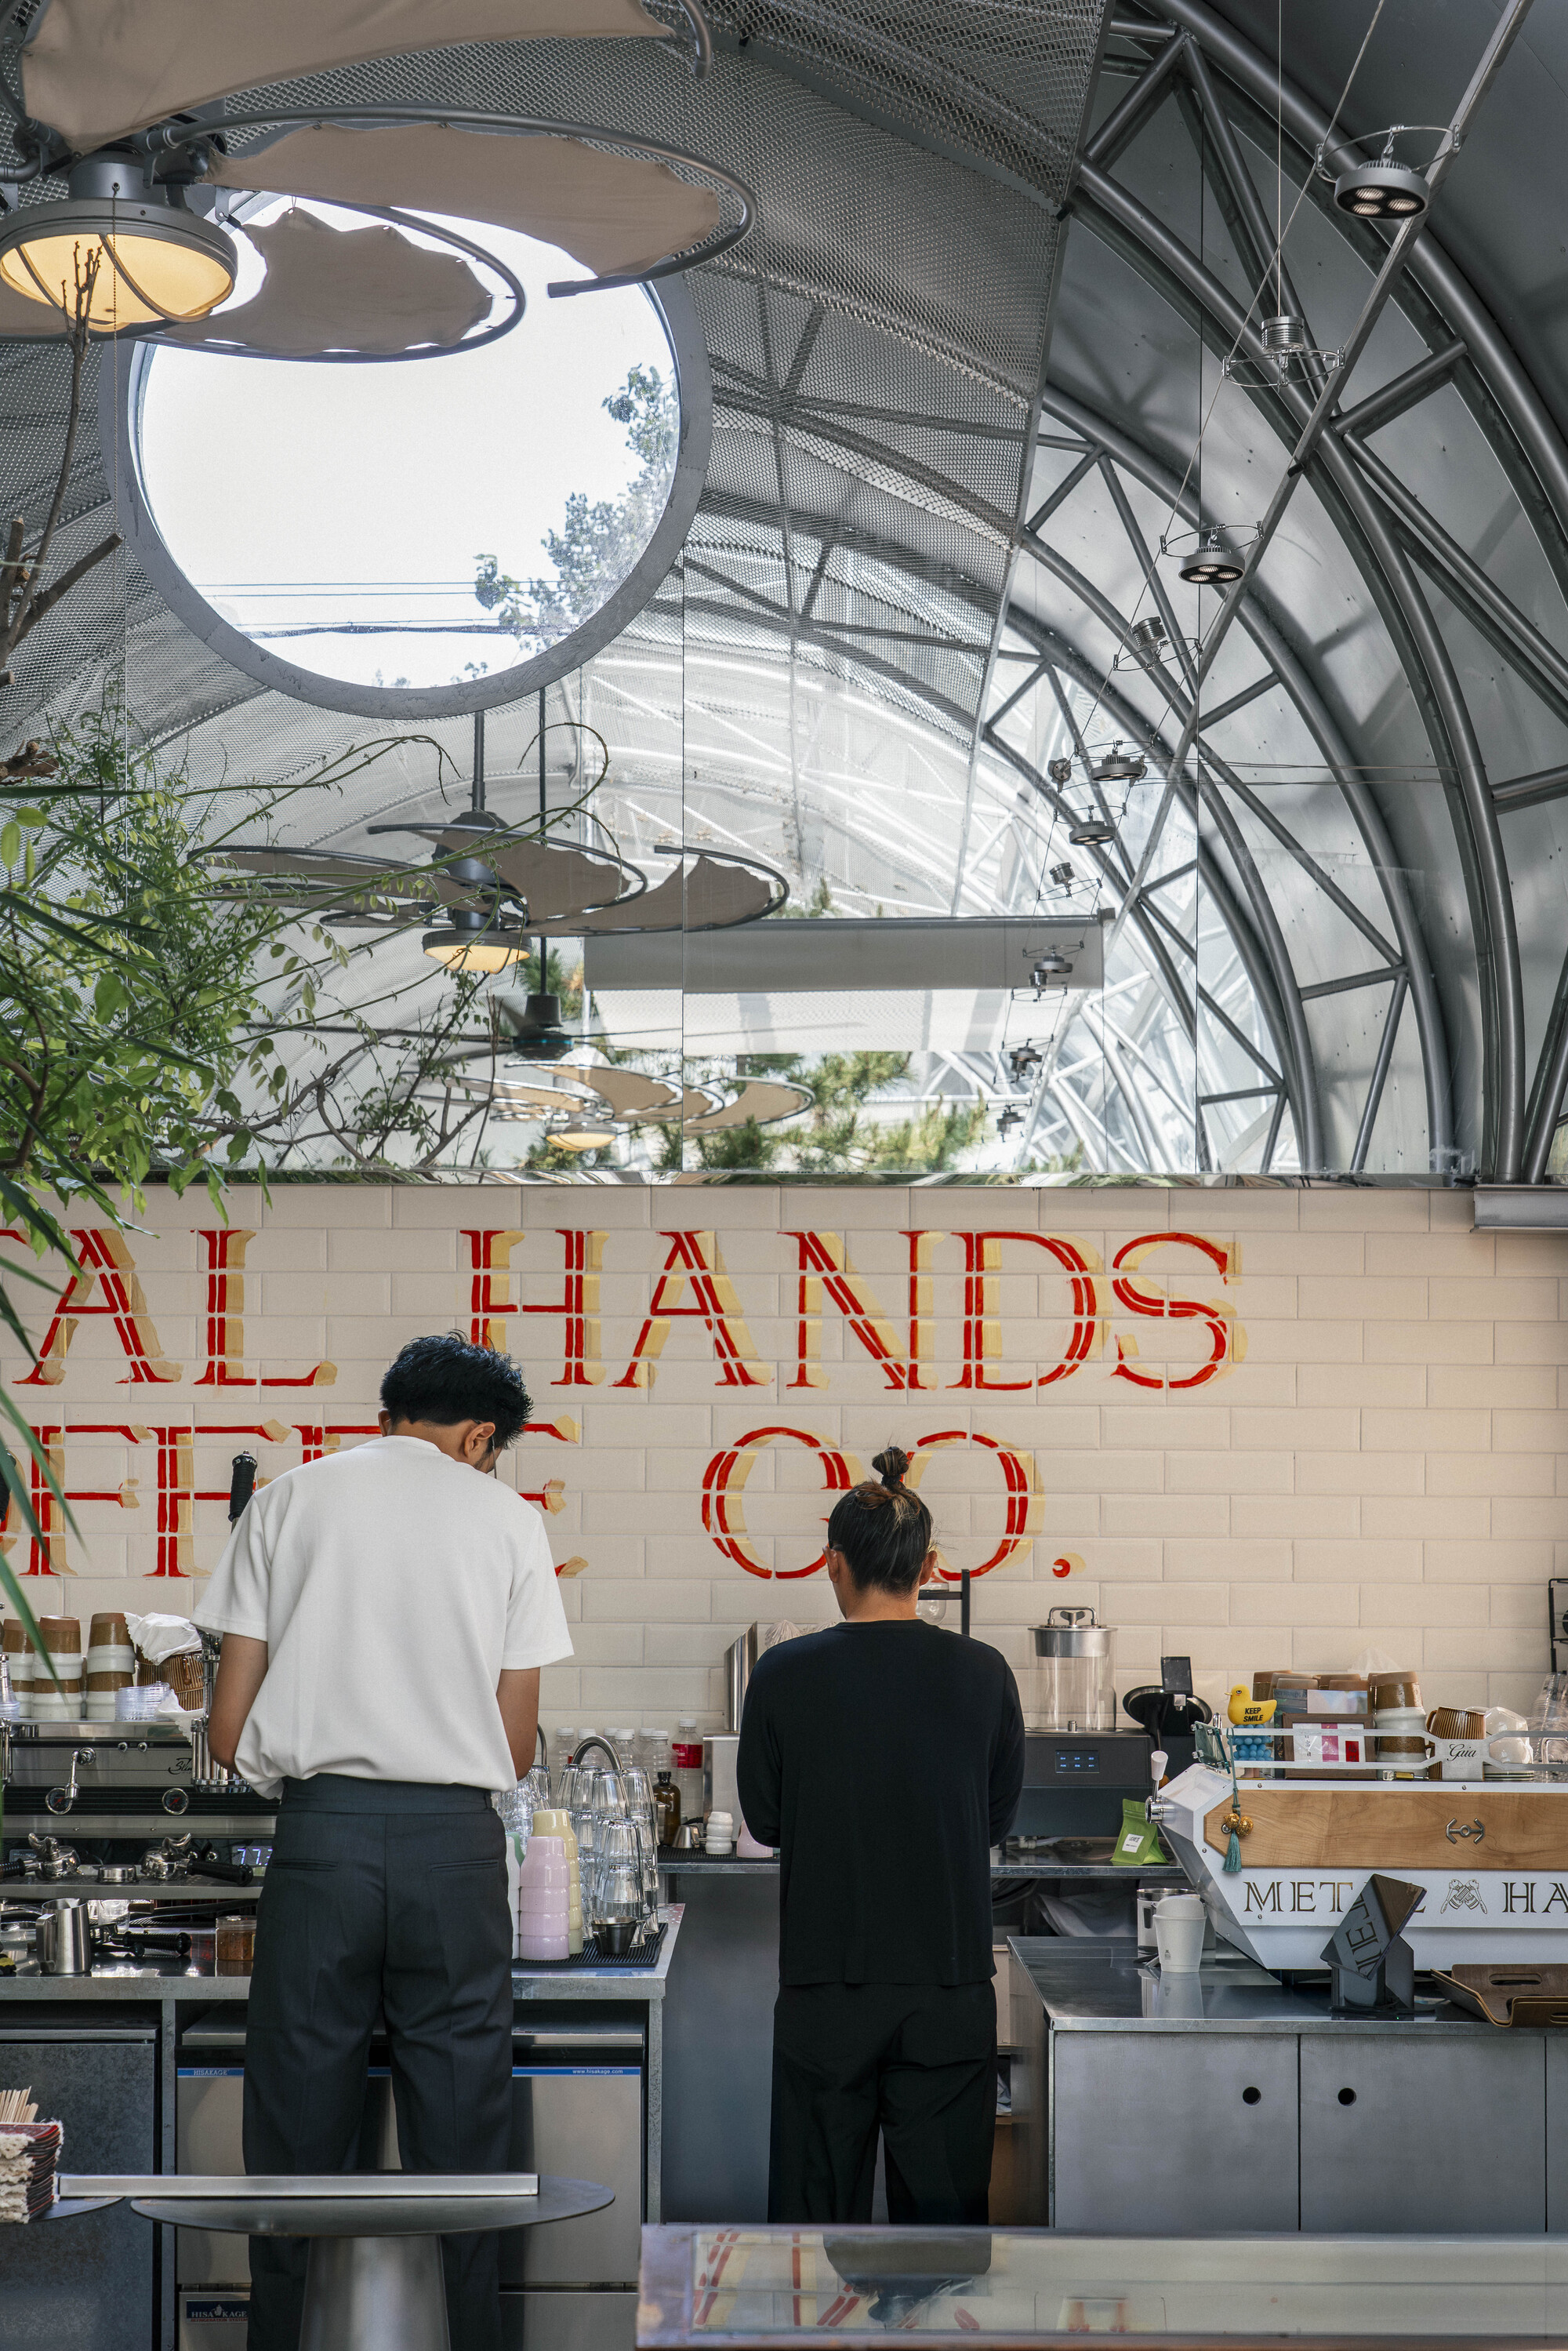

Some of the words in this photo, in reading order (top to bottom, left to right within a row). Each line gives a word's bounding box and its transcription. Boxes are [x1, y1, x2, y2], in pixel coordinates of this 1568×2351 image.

[0, 1229, 336, 1386] AL
[460, 1230, 1244, 1391] HANDS
[1446, 1743, 1477, 1761] Gaia
[1243, 1881, 1426, 1913] MET
